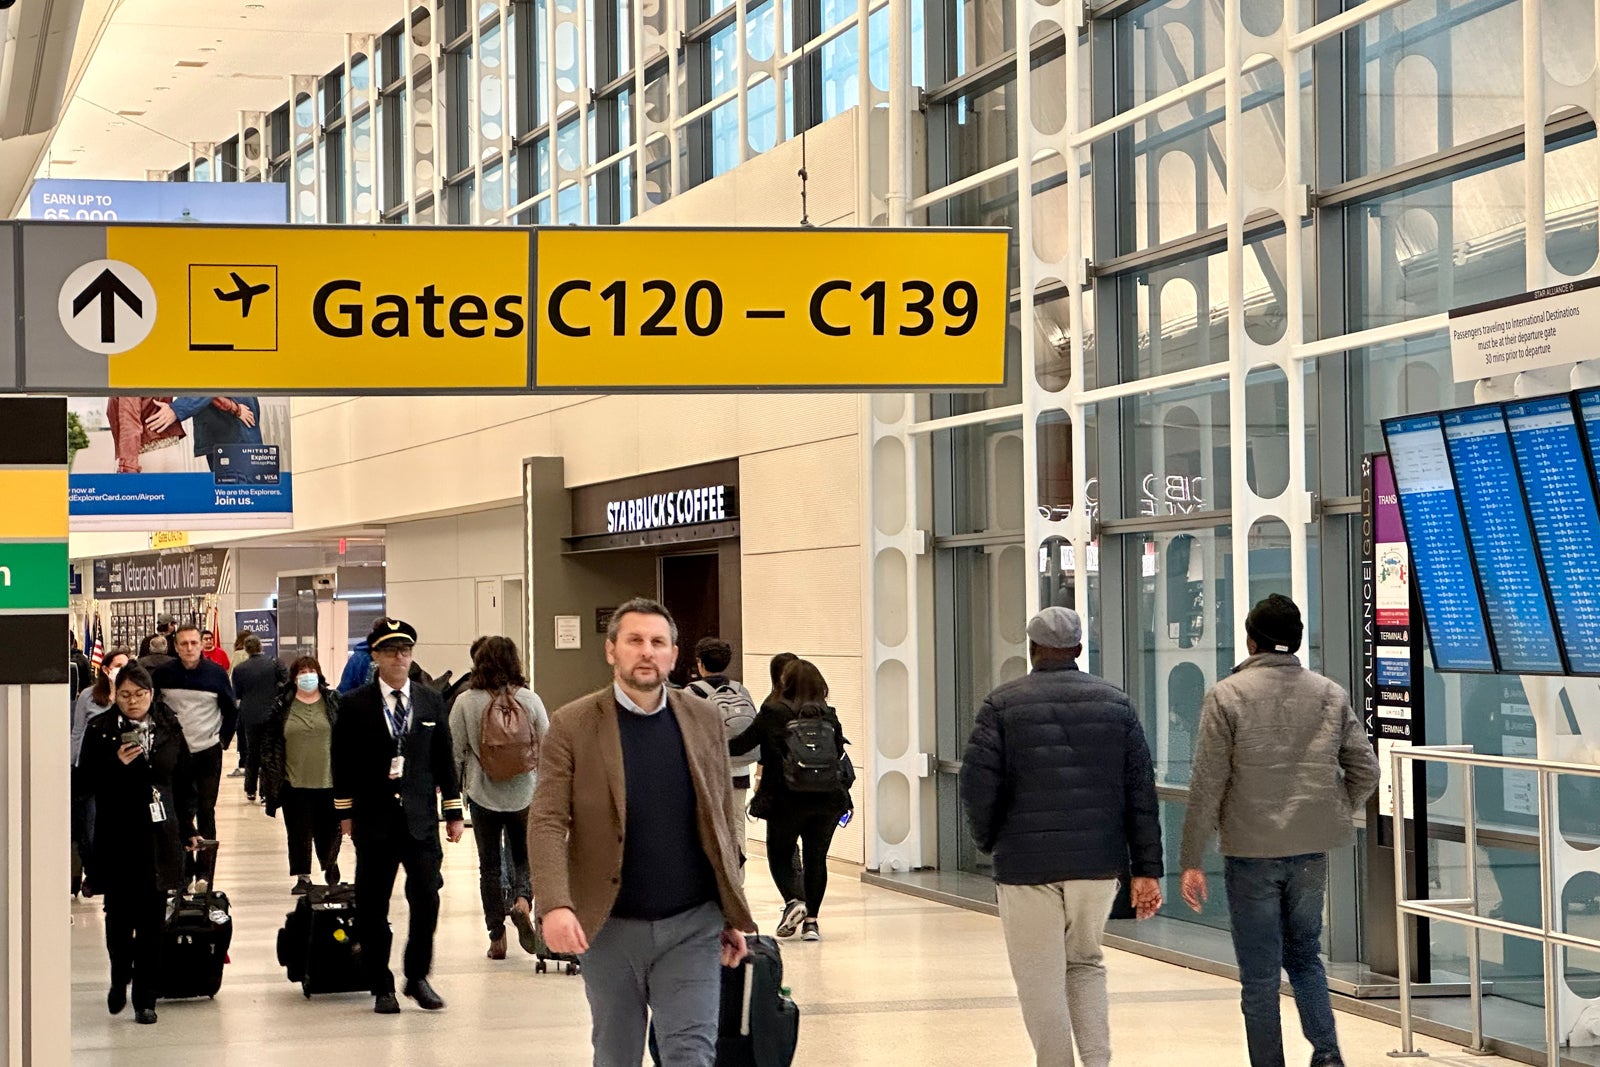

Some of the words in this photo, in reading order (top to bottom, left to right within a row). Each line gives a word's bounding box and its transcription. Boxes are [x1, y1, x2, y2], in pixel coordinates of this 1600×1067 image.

[43, 193, 76, 205] EARN
[78, 194, 94, 206] UP
[96, 195, 112, 206] TO
[44, 208, 118, 221] 65000
[312, 279, 524, 339] Gates
[547, 279, 723, 338] C120
[809, 279, 979, 338] C139
[1453, 326, 1482, 340] Passengers
[1482, 322, 1505, 336] traveling
[1505, 321, 1511, 330] to
[1512, 313, 1545, 328] International
[1546, 306, 1580, 322] Destinations
[1477, 338, 1491, 350] must
[1491, 337, 1499, 348] be
[1499, 338, 1504, 347] at
[1504, 335, 1517, 346] their
[1517, 329, 1543, 345] departure
[1544, 327, 1557, 341] gate
[1485, 354, 1492, 364] 30
[1492, 351, 1505, 363] mins
[1505, 349, 1518, 363] prior
[1518, 348, 1525, 358] to
[1525, 344, 1551, 359] departure
[214, 495, 236, 506] Join
[237, 496, 255, 506] us.
[238, 488, 249, 496] the
[249, 488, 283, 497] Explorers.
[607, 491, 675, 533] STARBUCKS
[676, 485, 725, 524] COFFEE
[1362, 487, 1371, 556] GOLD
[122, 560, 156, 592] Veterans
[156, 557, 181, 591] Honor
[181, 554, 199, 589] Wall
[243, 624, 270, 632] POLARIS
[1363, 567, 1373, 688] ALLIANCE
[1380, 631, 1403, 641] TERMINAL
[1381, 691, 1404, 701] TERMINAL
[1364, 697, 1374, 750] TAR
[1381, 724, 1405, 735] TERMINAL
